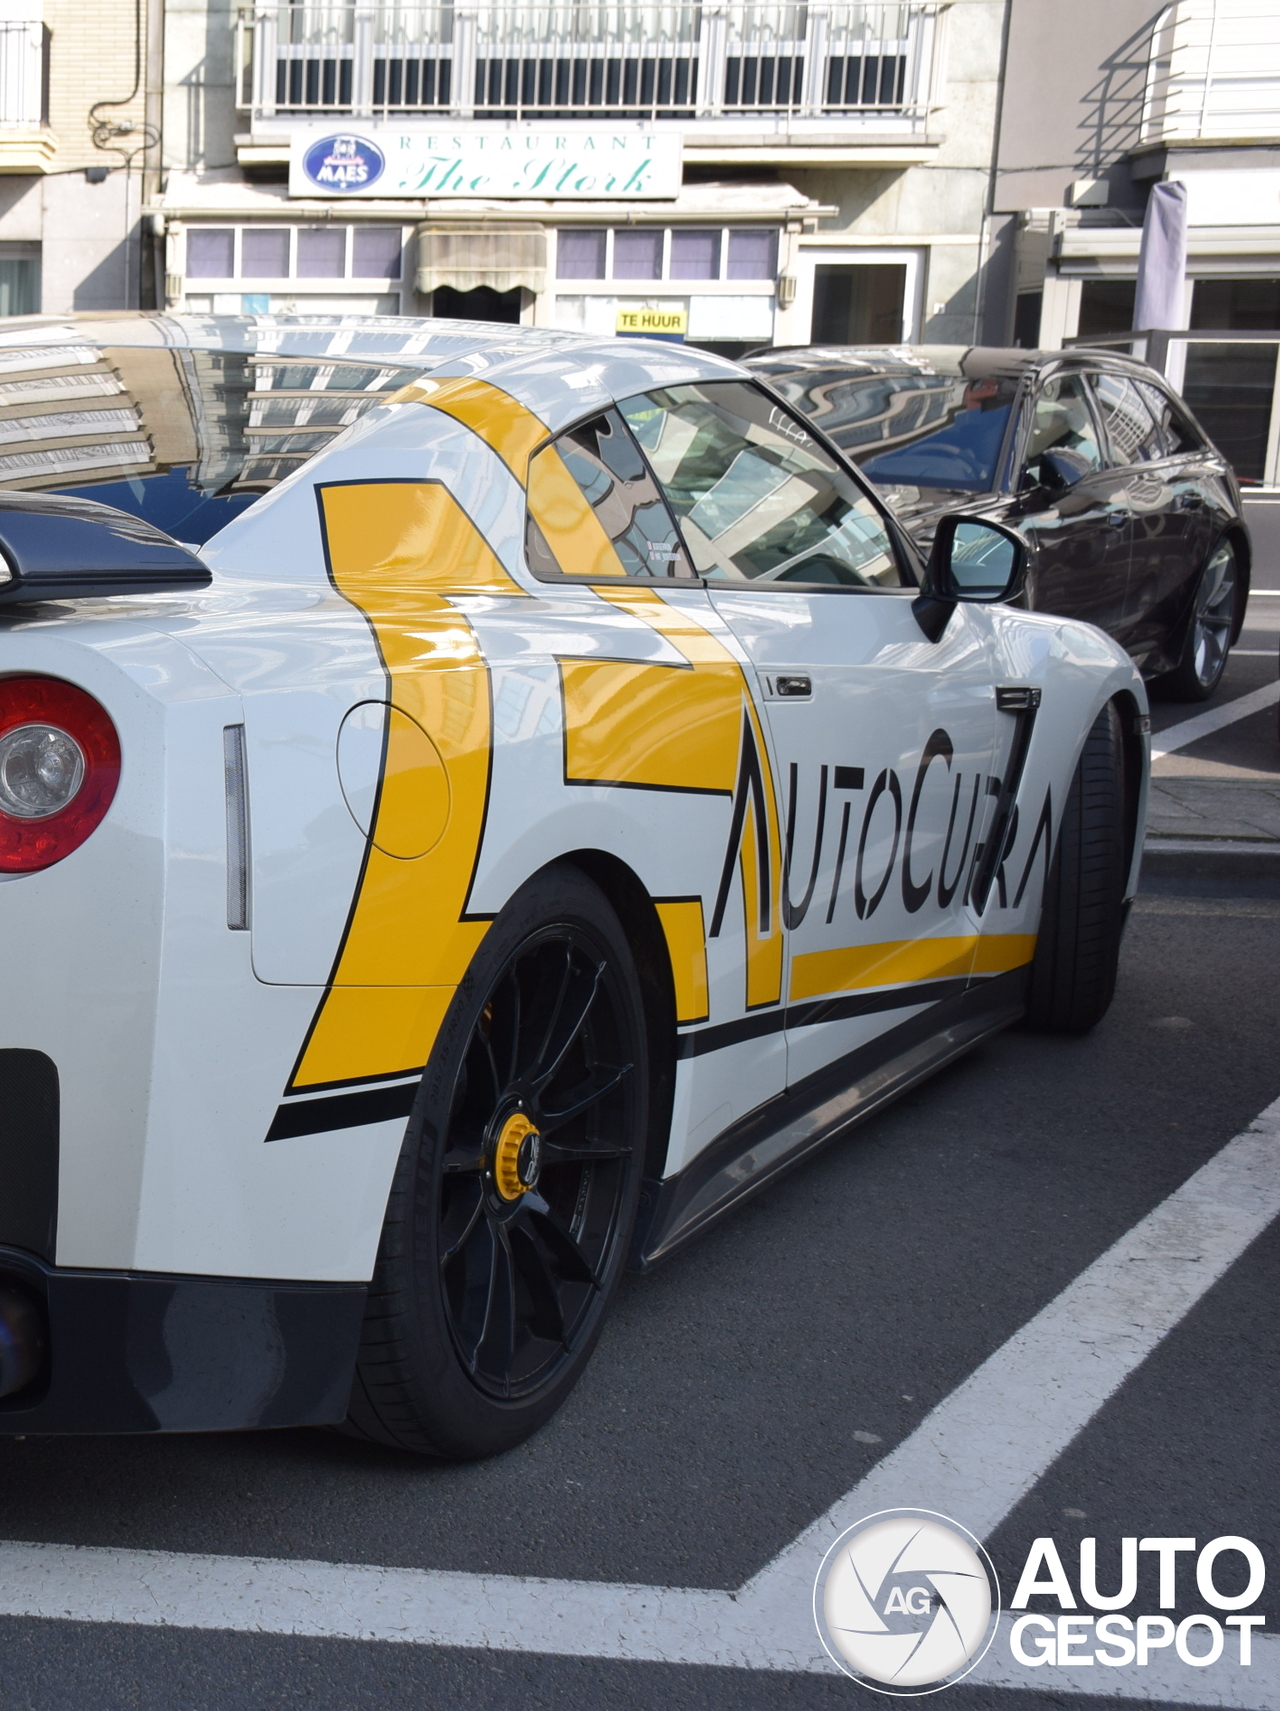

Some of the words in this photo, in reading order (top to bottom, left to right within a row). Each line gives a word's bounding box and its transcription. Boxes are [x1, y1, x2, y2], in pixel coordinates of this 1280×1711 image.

[399, 135, 657, 150] RESTAURANT
[316, 164, 369, 182] MAES
[399, 155, 491, 192] The
[512, 157, 654, 193] Stork
[621, 314, 638, 327] TE
[641, 314, 681, 328] HUUR
